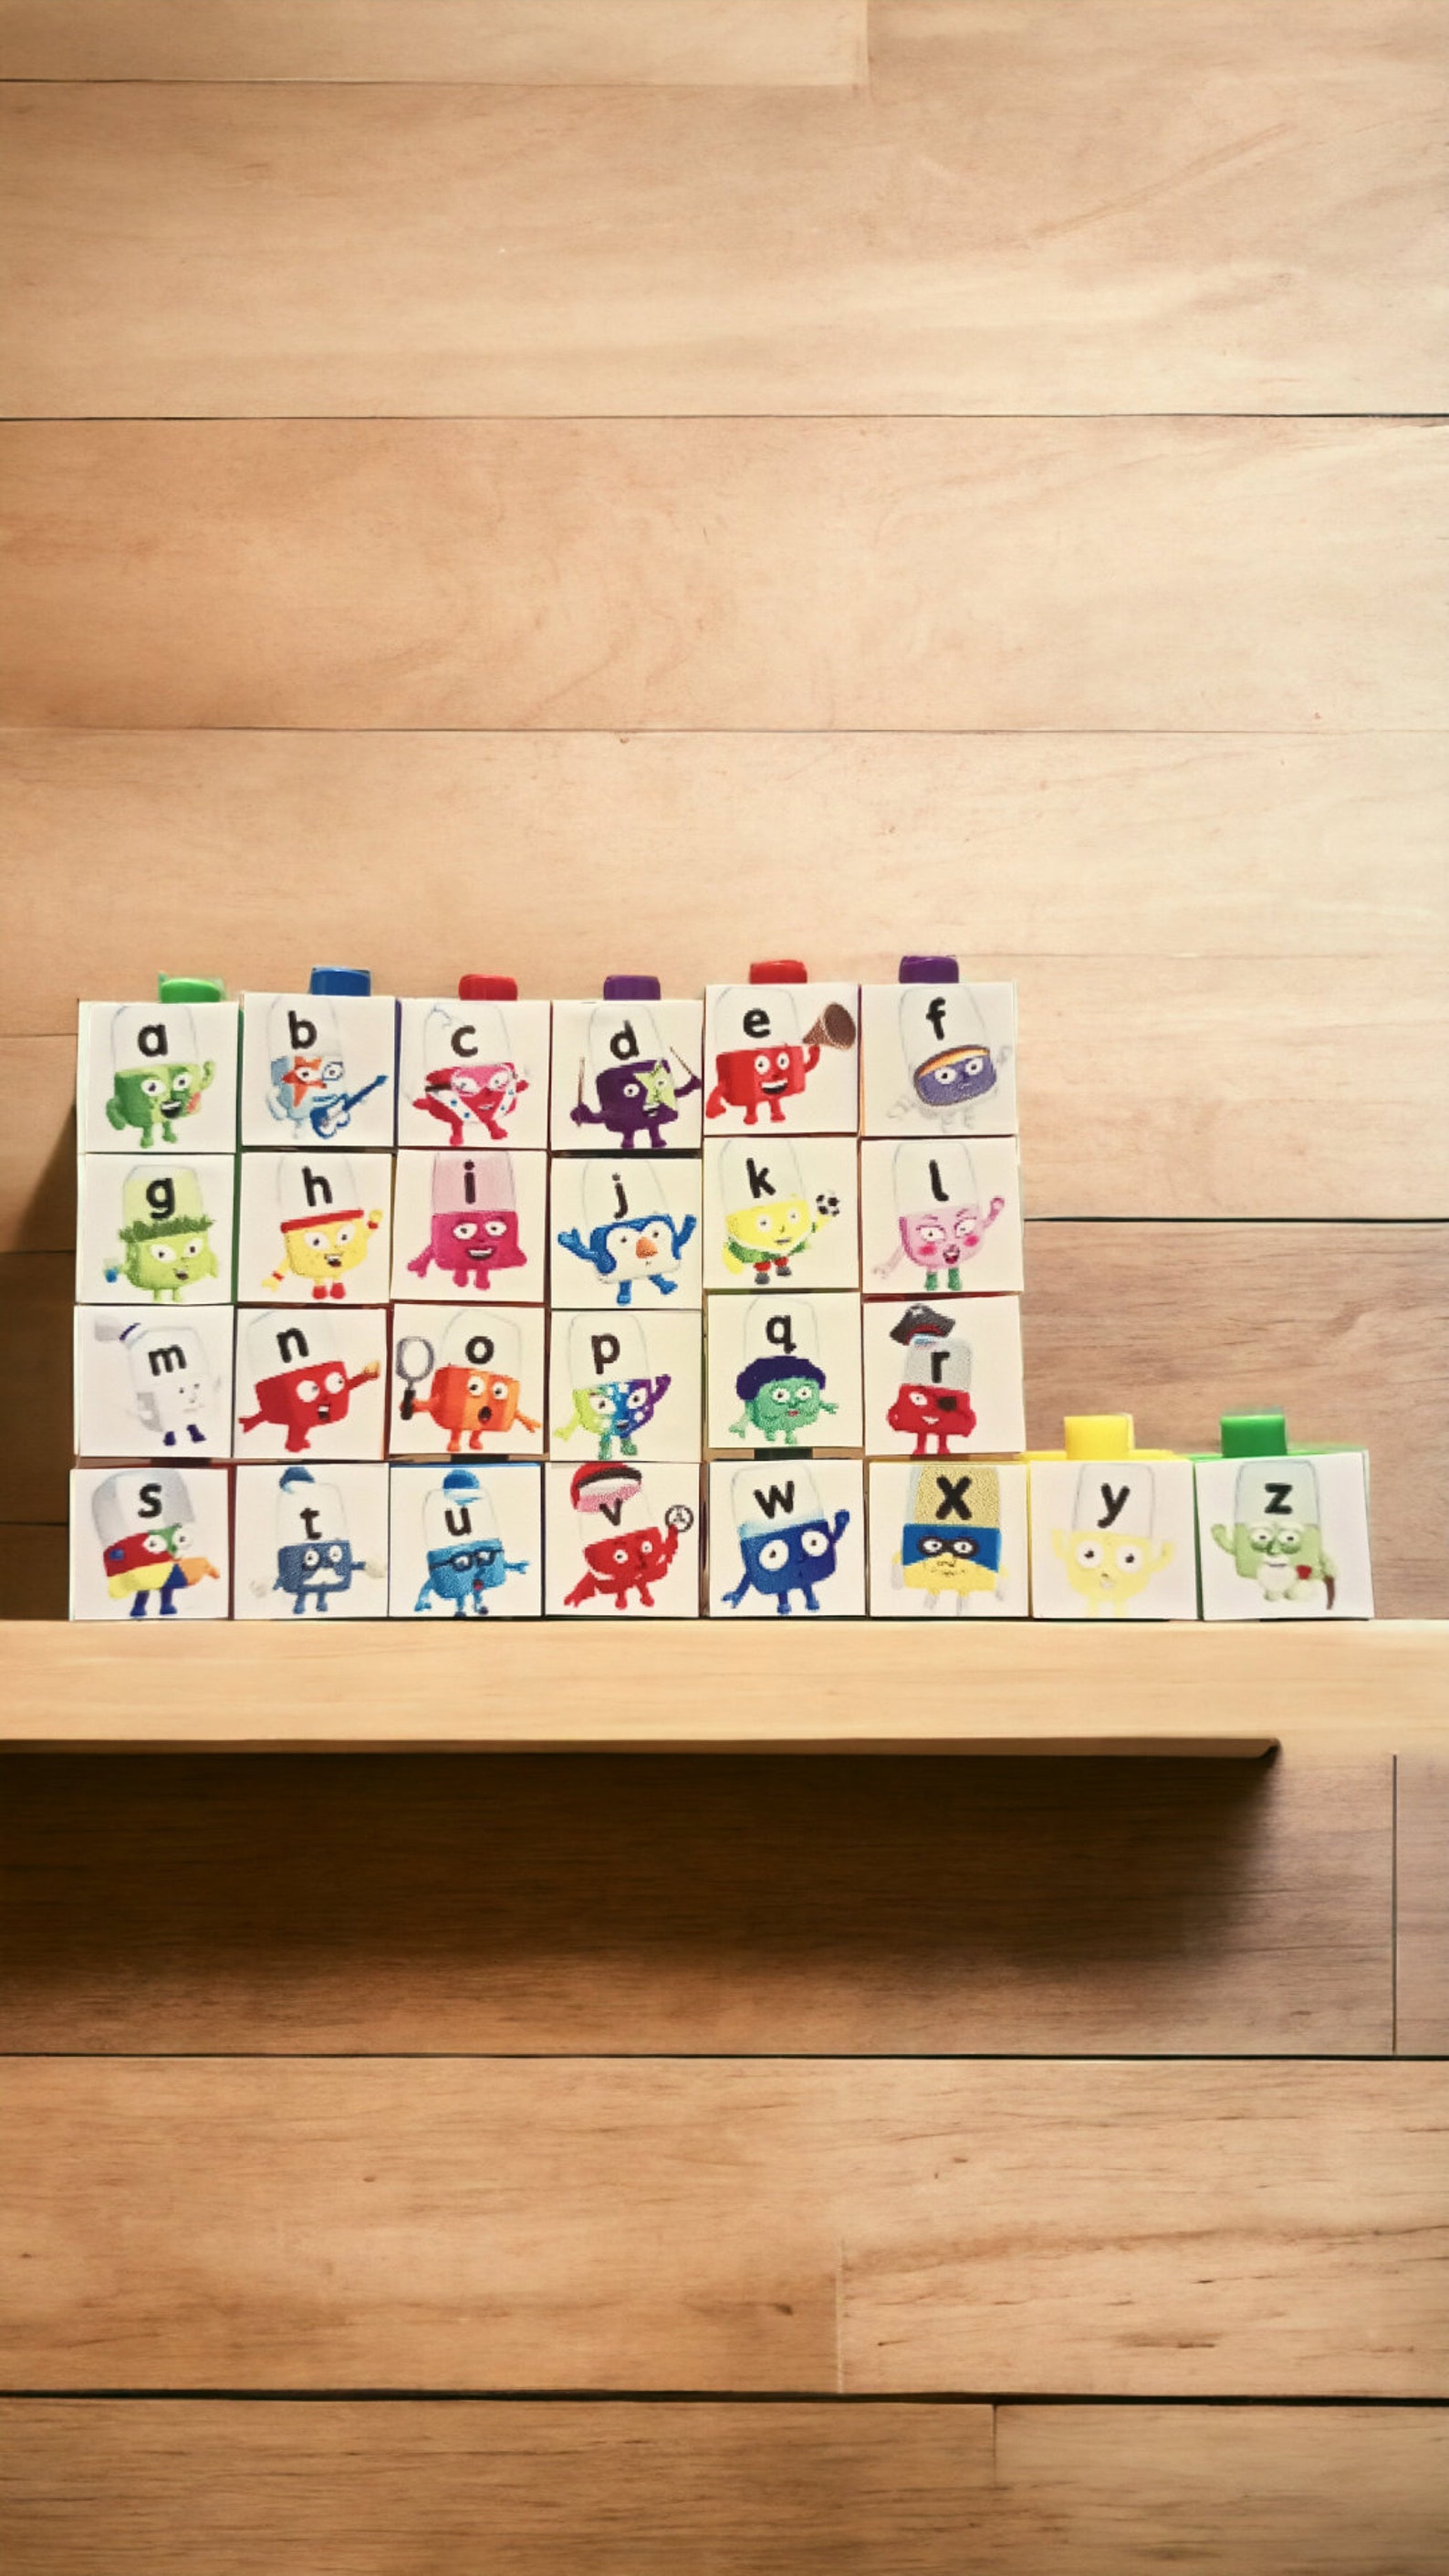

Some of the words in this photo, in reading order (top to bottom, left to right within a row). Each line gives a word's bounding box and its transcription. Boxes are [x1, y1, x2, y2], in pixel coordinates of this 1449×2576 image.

[287, 1010, 317, 1050] b
[743, 1008, 771, 1038] e
[925, 996, 946, 1040] f
[137, 1024, 168, 1058] a
[451, 1026, 478, 1058] c
[610, 1020, 640, 1060] d
[302, 1166, 332, 1207] h
[464, 1161, 475, 1205] i
[612, 1174, 629, 1219] j
[745, 1158, 777, 1199] k
[929, 1160, 949, 1202] l
[145, 1177, 175, 1222] g
[276, 1328, 309, 1363] n
[465, 1336, 495, 1365] o
[766, 1313, 797, 1354] q
[148, 1345, 186, 1376] m
[591, 1334, 620, 1375] p
[931, 1351, 951, 1384] r
[138, 1483, 162, 1518] s
[599, 1497, 623, 1527] v
[754, 1480, 795, 1519] w
[1098, 1484, 1131, 1528] y
[1265, 1483, 1292, 1515] z
[299, 1507, 321, 1540] t
[444, 1507, 472, 1537] u
